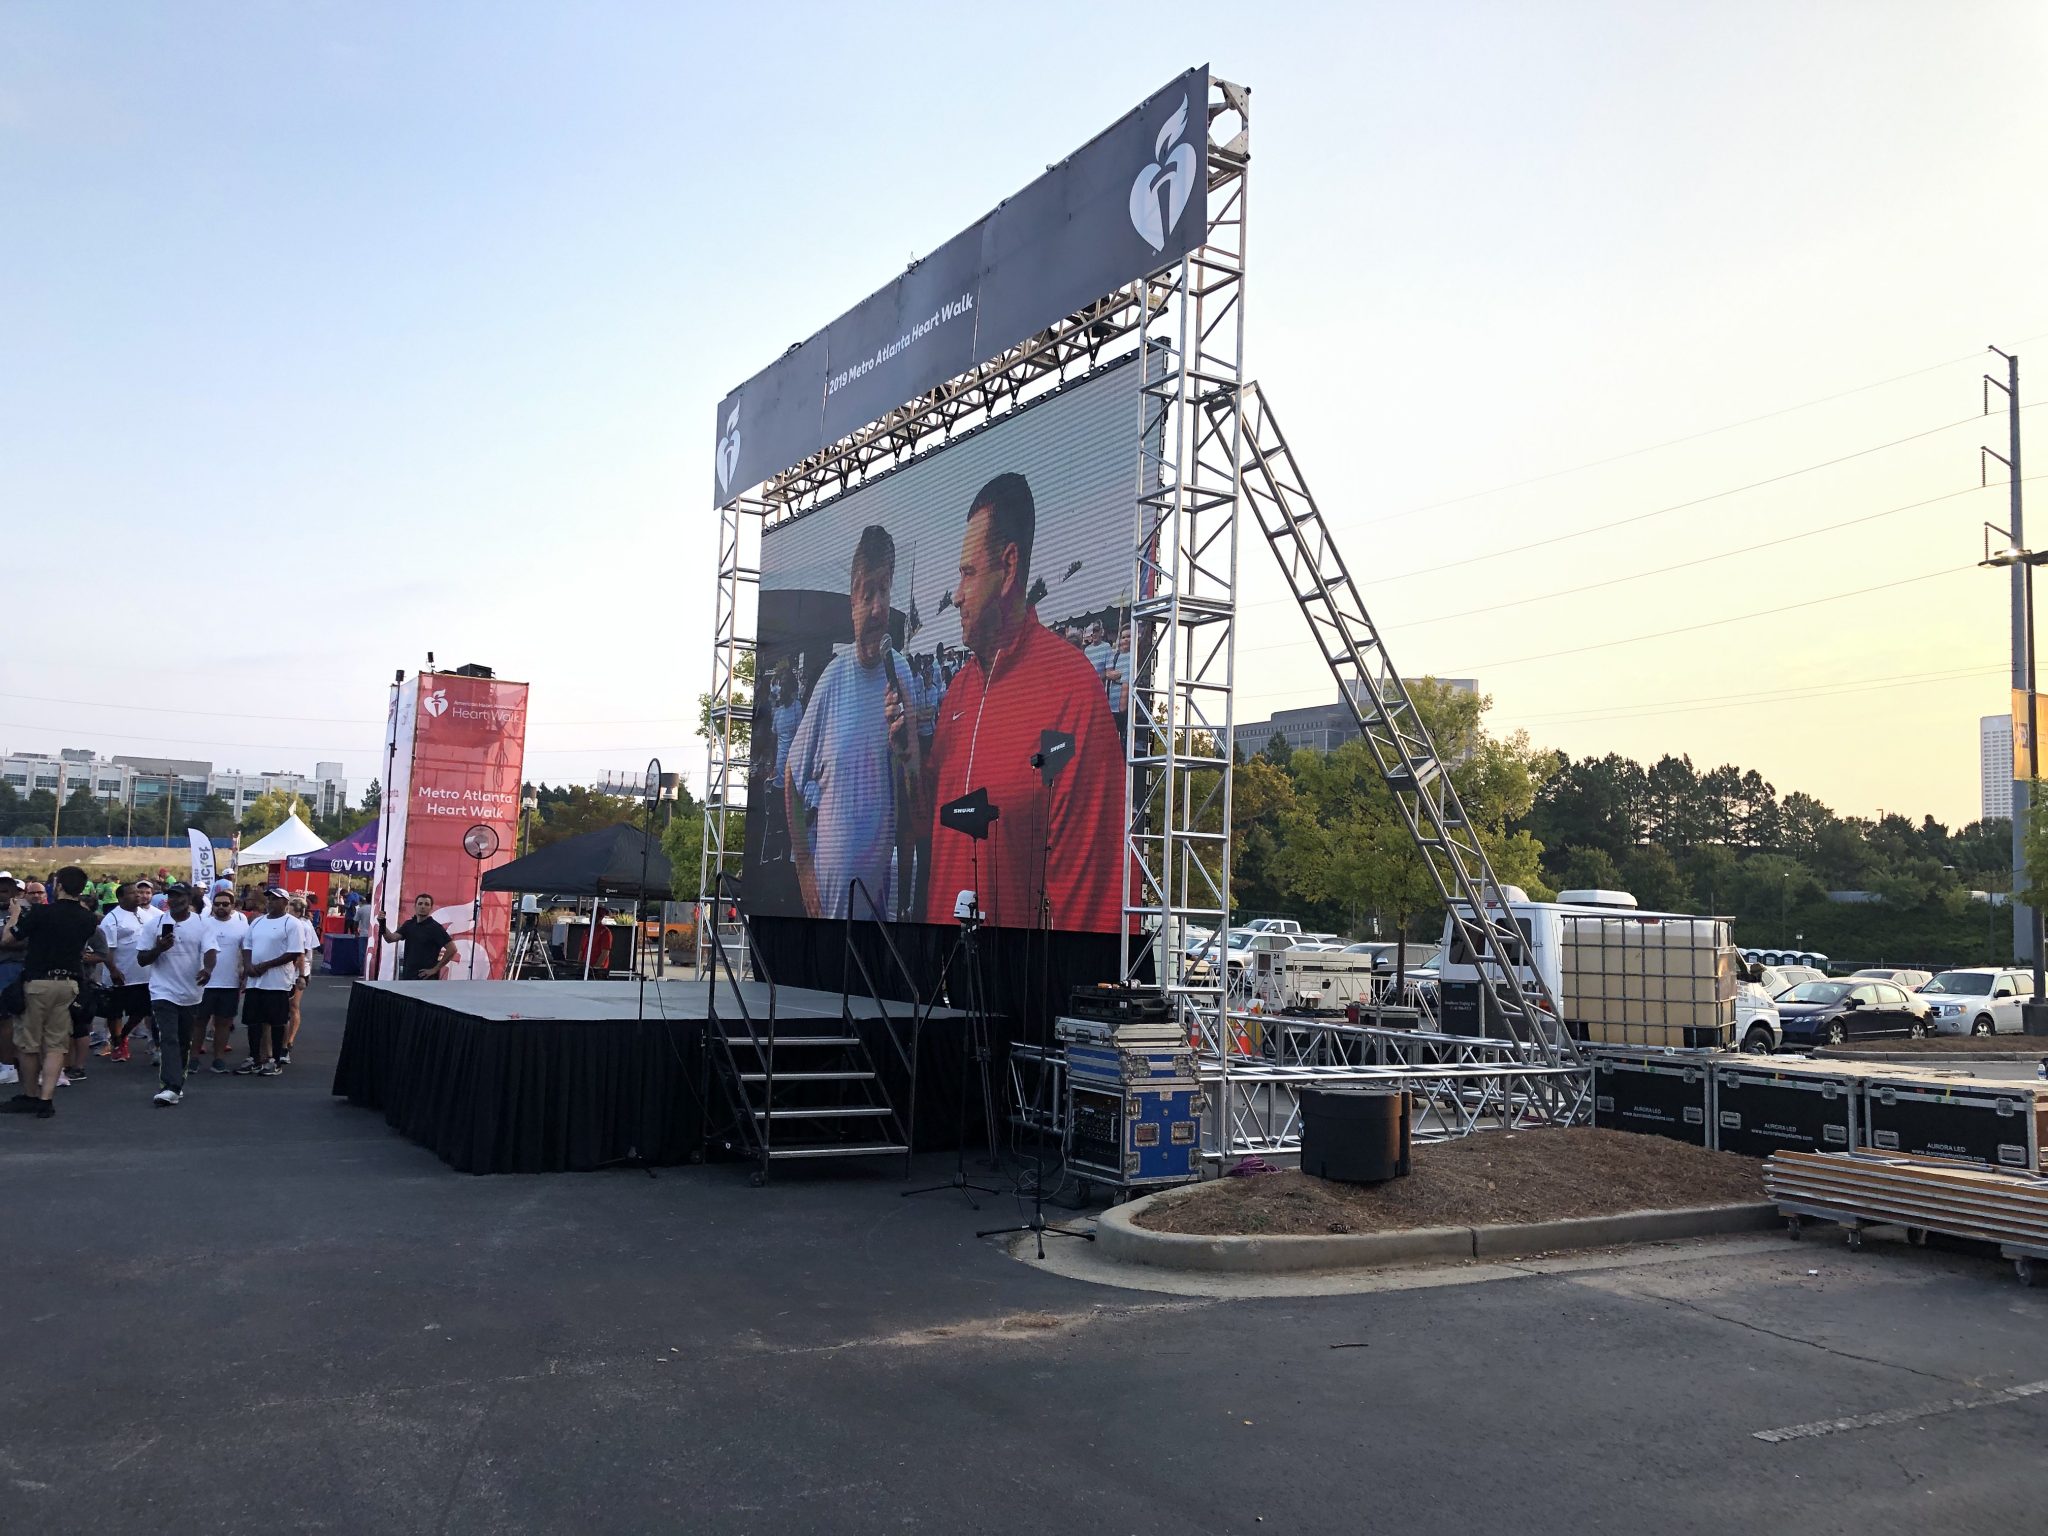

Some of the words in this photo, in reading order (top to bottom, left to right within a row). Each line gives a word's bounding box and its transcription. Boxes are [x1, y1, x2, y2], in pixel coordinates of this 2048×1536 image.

[828, 371, 848, 396] 2019
[848, 358, 875, 384] Metro
[875, 334, 911, 367] Atlanta
[911, 311, 940, 343] Heart
[941, 292, 974, 323] Walk
[452, 707, 489, 721] Heart
[491, 709, 521, 722] Walk
[1050, 742, 1066, 753] SHURE
[419, 786, 460, 800] Metro
[462, 789, 513, 804] Atlanta
[426, 803, 467, 816] Heart
[470, 805, 504, 819] Walk
[331, 859, 376, 872] @V10
[1764, 1123, 1786, 1131] AURORA
[1927, 1142, 1953, 1151] AURORA
[1954, 1145, 1966, 1153] LED
